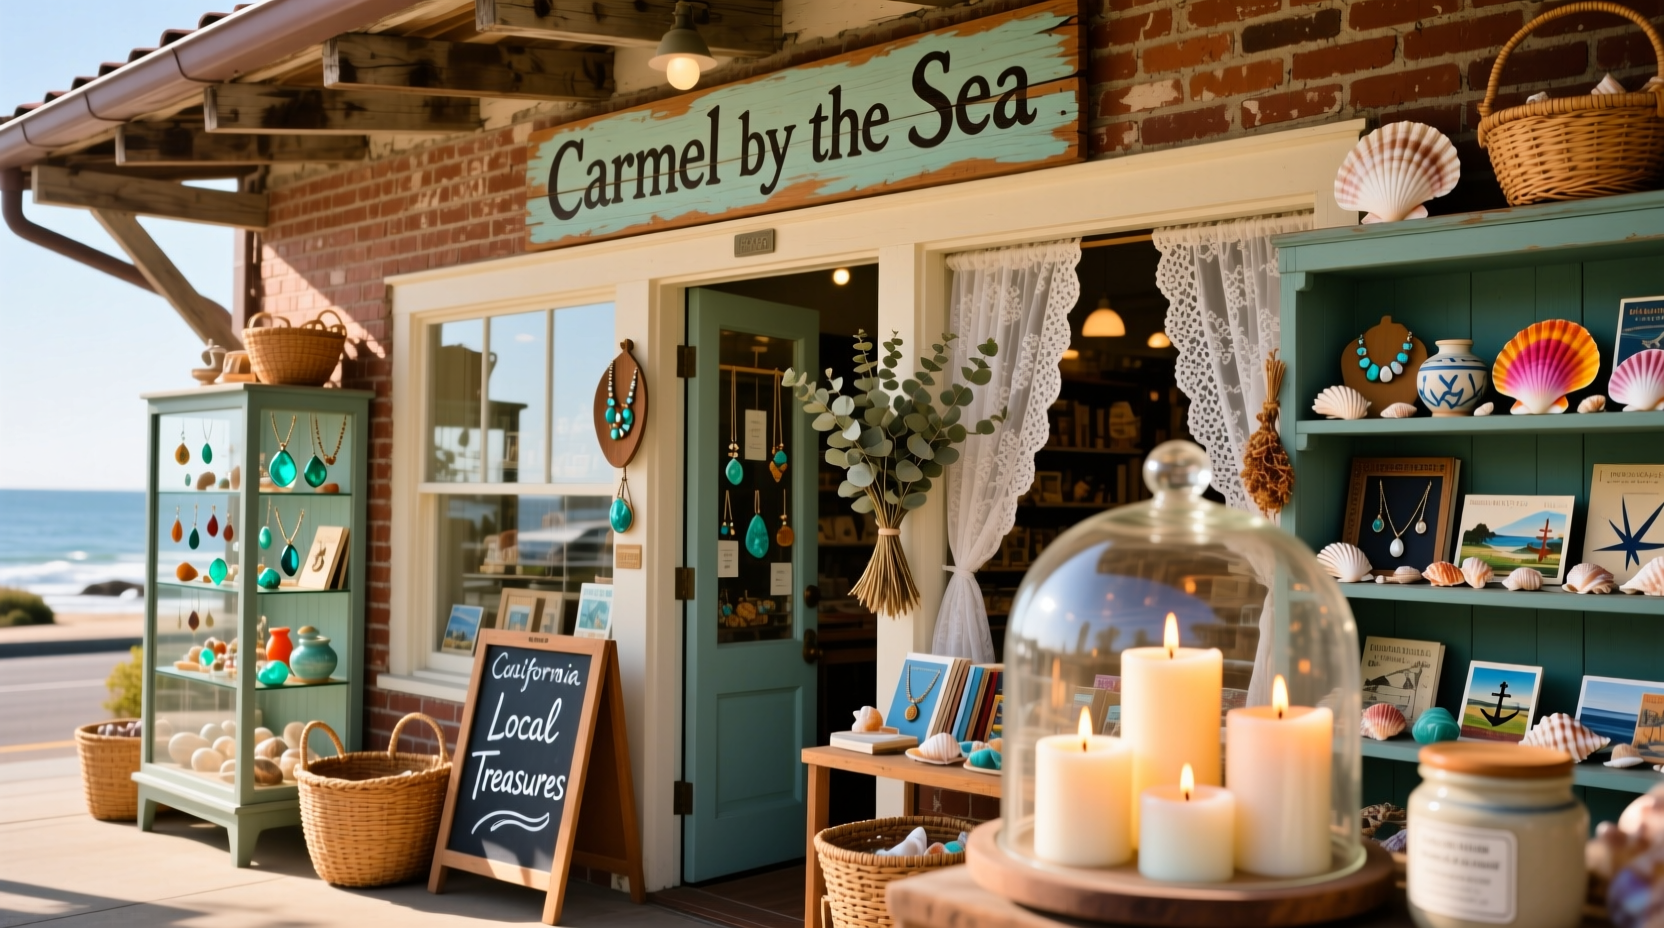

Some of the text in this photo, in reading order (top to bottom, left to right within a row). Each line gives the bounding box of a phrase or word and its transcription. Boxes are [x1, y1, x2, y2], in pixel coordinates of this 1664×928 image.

[548, 50, 1037, 221] Carmel by the Sea
[487, 692, 562, 744] Local
[472, 750, 566, 801] Treasures
